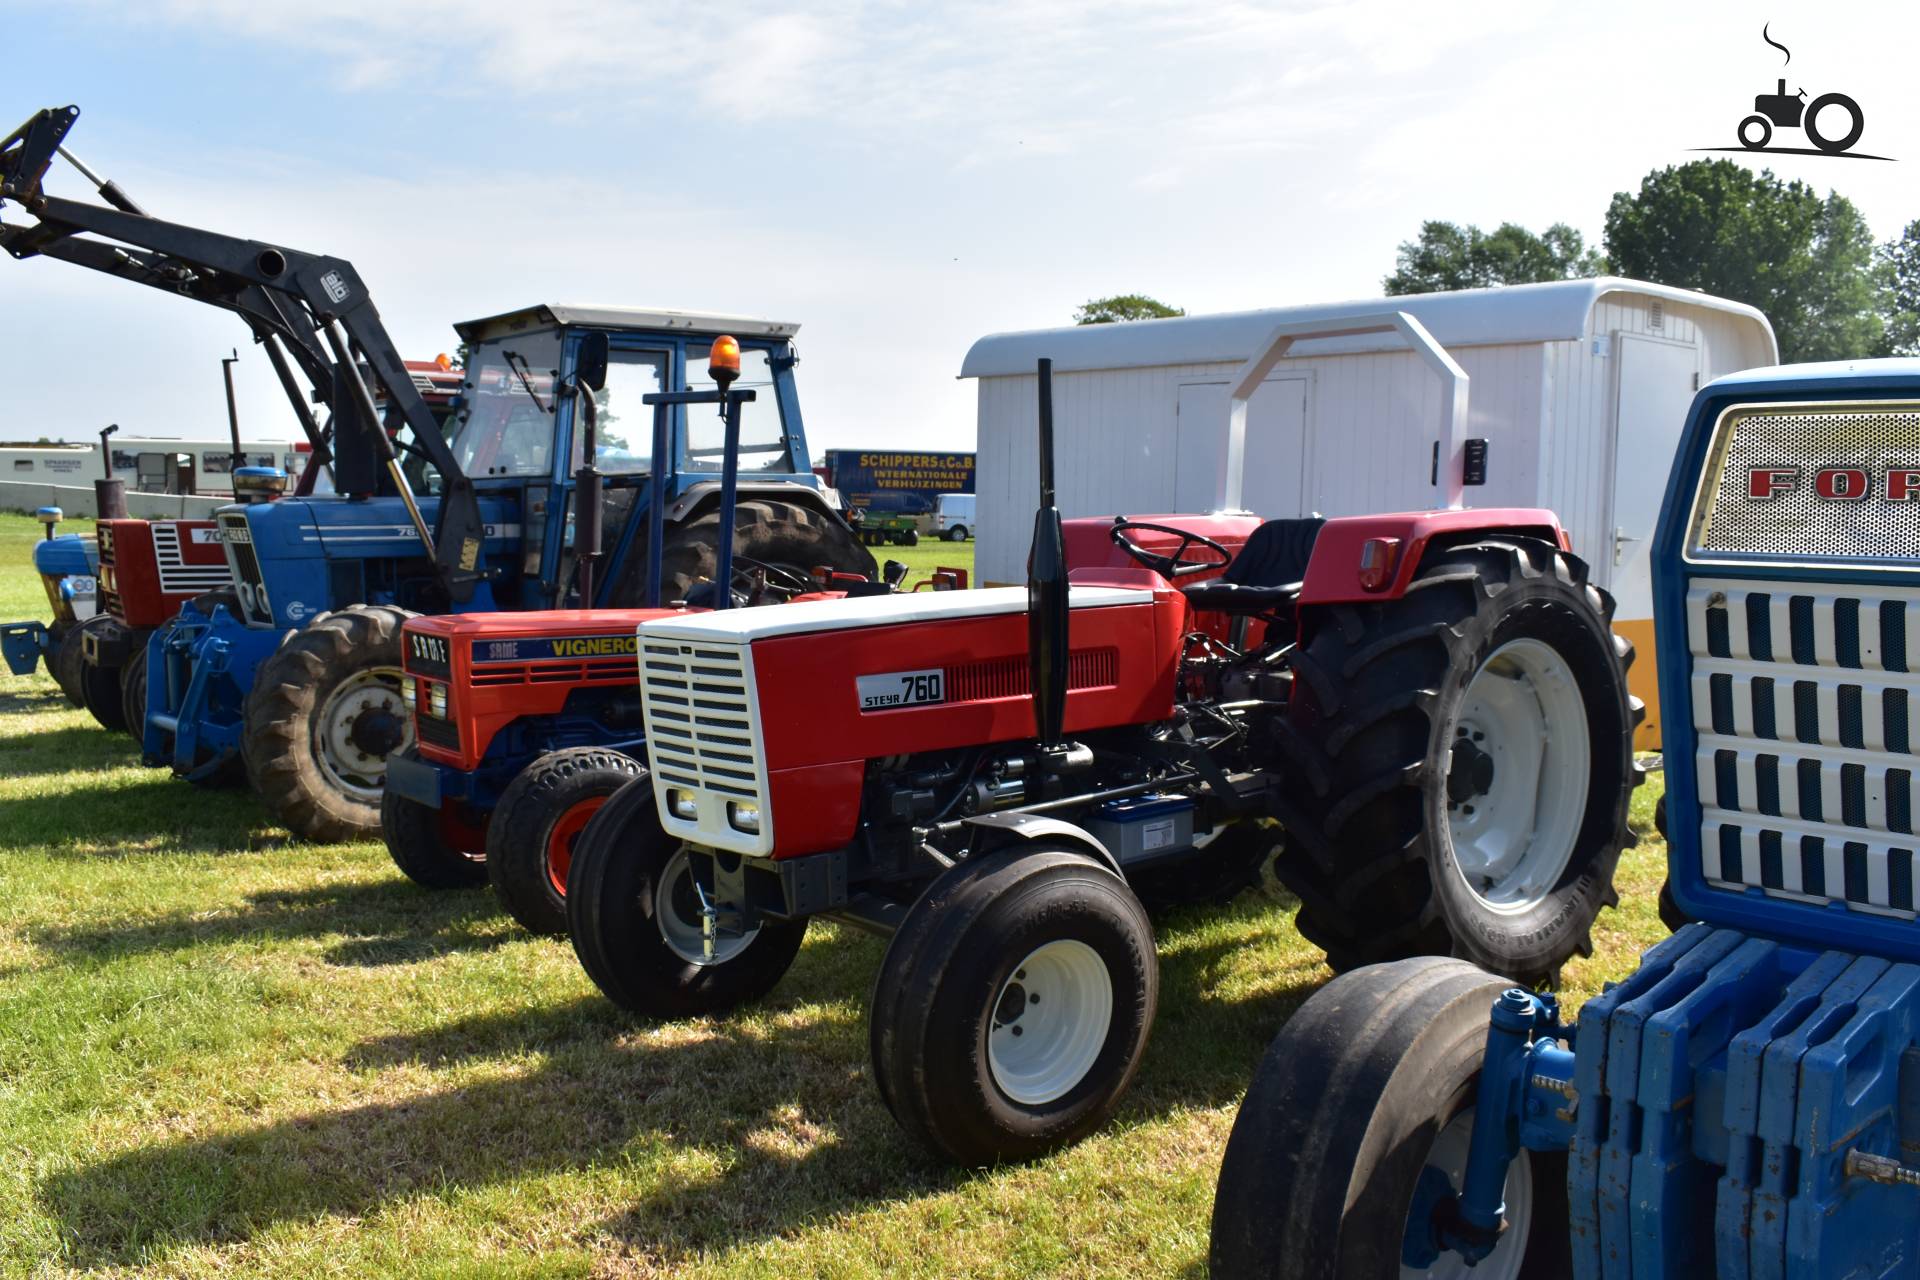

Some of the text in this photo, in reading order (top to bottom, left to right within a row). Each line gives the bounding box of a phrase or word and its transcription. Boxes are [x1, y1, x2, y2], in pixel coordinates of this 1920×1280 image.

[860, 454, 938, 468] SCHIPPERS
[874, 470, 967, 479] INTERNATIONALE
[878, 480, 962, 489] VERHUIZINGEN
[413, 635, 446, 663] SAME
[489, 638, 636, 659] SAME VIGNERO
[864, 675, 940, 706] STEYR 760
